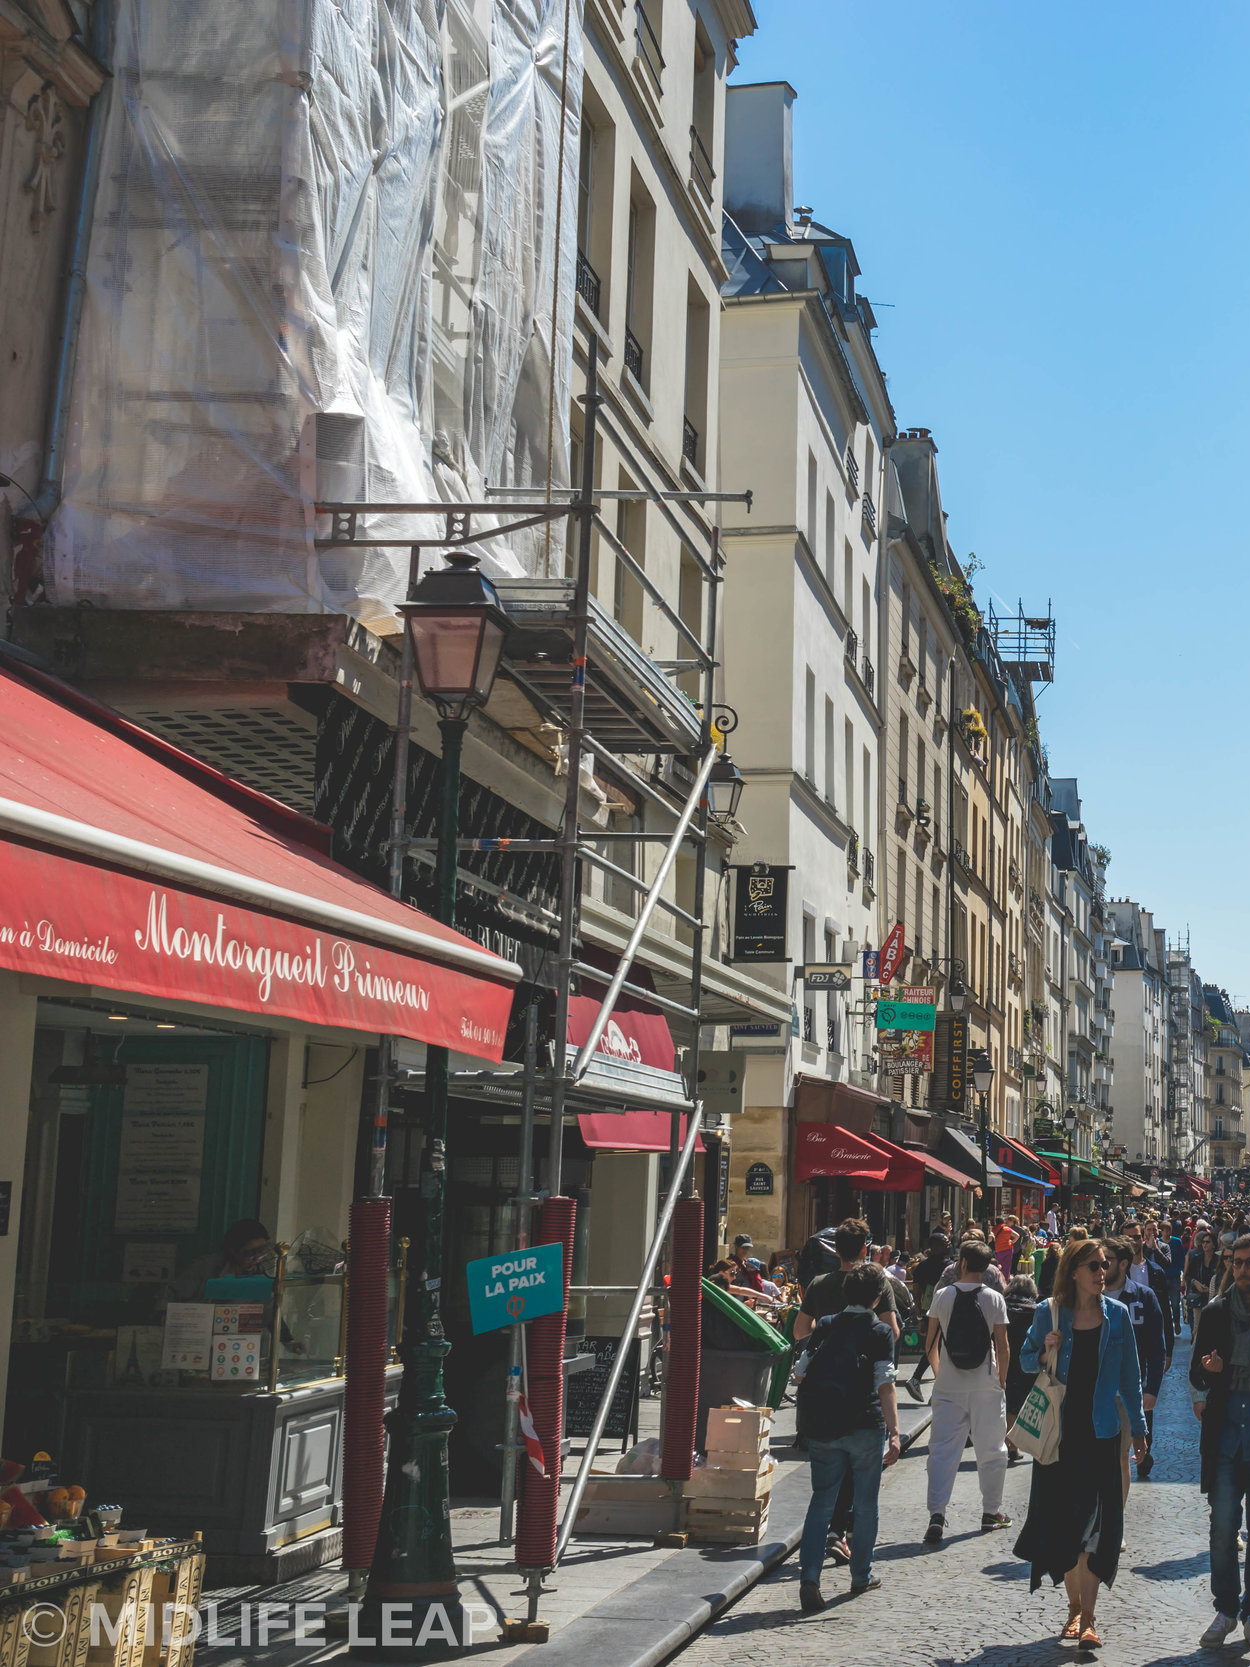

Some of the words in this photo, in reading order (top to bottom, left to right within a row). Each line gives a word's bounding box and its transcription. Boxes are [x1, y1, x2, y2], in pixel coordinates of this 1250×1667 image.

[19, 921, 36, 948] à
[36, 919, 119, 965] Domicile
[135, 891, 327, 1002] Montorgueil
[332, 942, 430, 1011] Primeur
[882, 930, 902, 979] TABAC
[811, 974, 829, 983] FDJ
[887, 1061, 924, 1069] BOULANGER
[952, 1021, 963, 1100] COIFFIRST
[888, 1068, 920, 1076] PATISSIER
[806, 1131, 827, 1143] Bar
[831, 1147, 872, 1160] Brasserie
[492, 1257, 537, 1278] POUR
[485, 1282, 505, 1298] LA
[509, 1272, 546, 1291] PAIX
[1129, 1302, 1144, 1324] C
